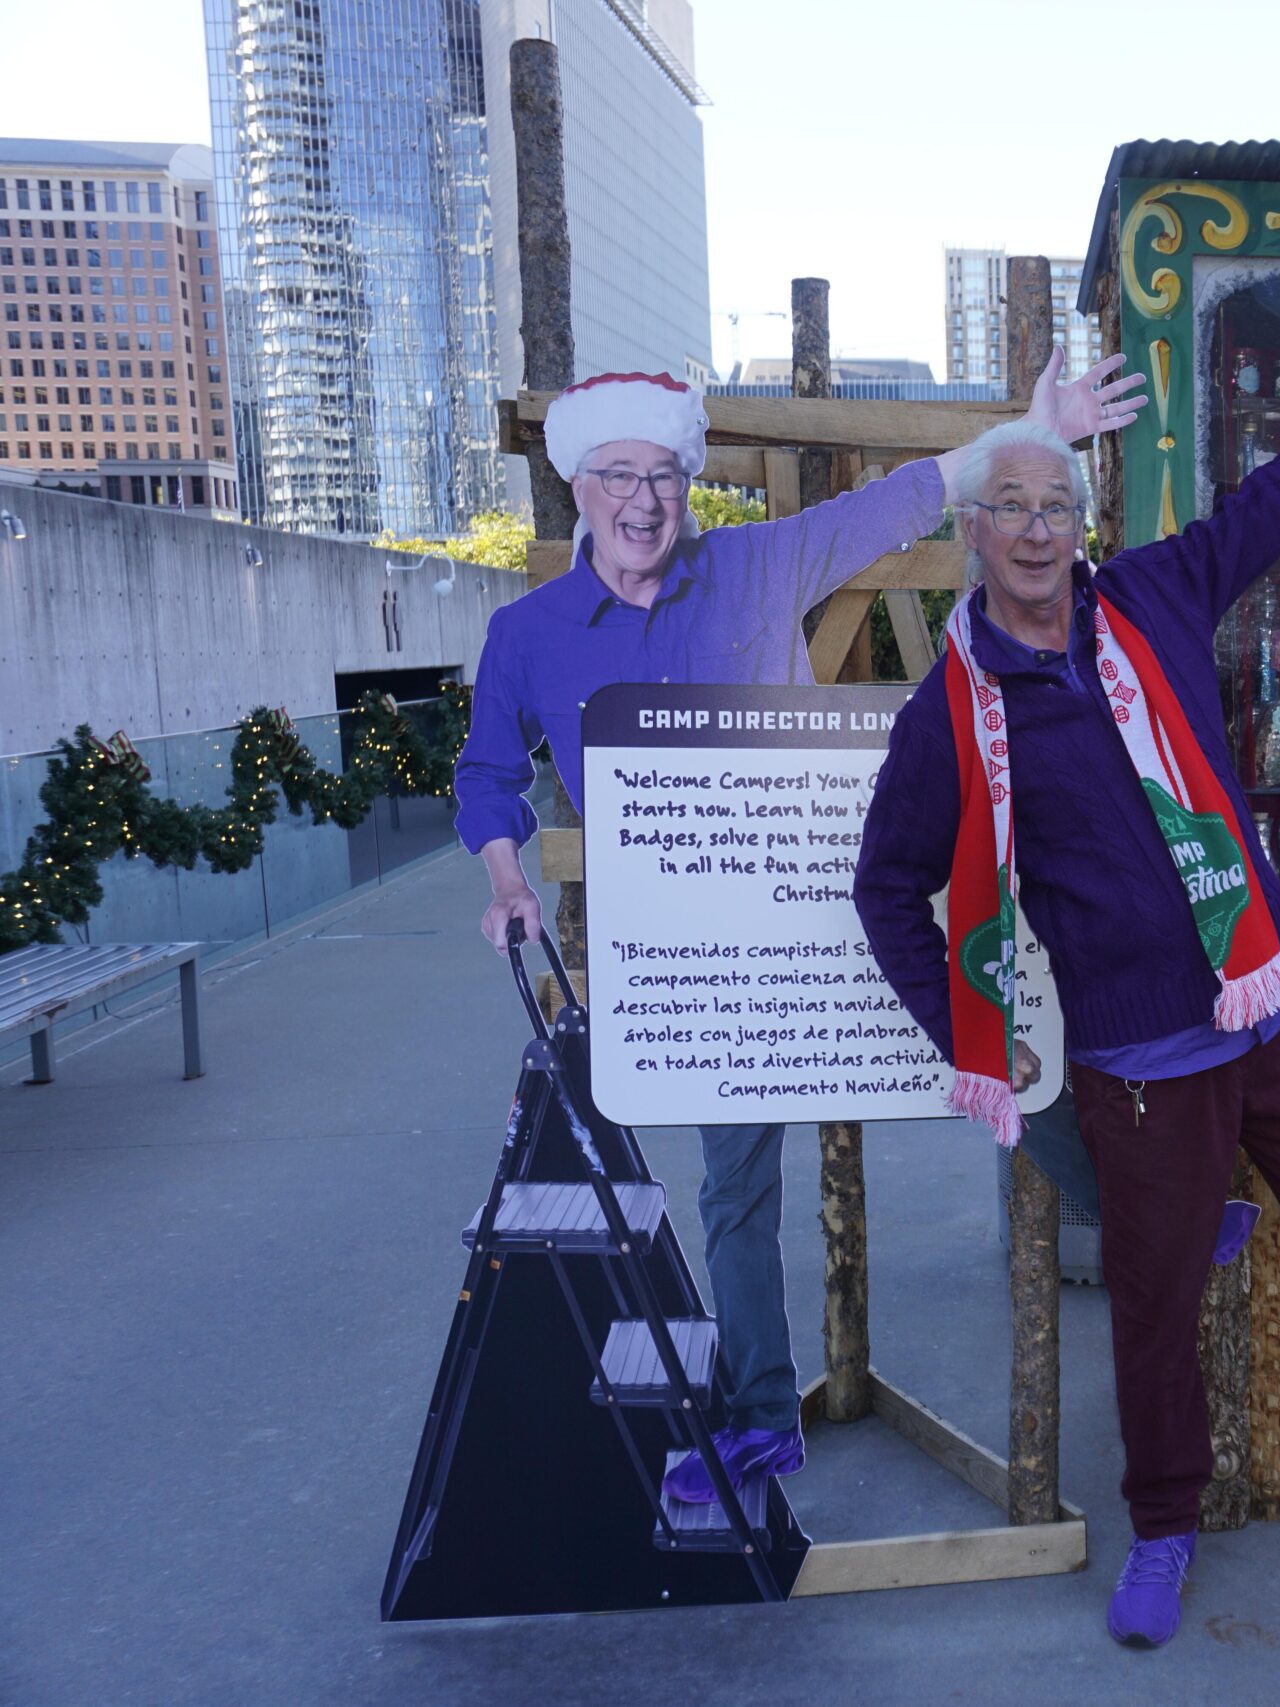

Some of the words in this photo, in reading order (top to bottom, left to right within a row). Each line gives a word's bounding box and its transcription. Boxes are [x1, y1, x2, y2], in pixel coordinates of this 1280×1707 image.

[639, 709, 710, 730] CAMP
[718, 710, 841, 731] DIRECTOR
[850, 712, 895, 731] LON
[719, 770, 810, 793] Campers!
[816, 772, 861, 792] Your
[622, 800, 687, 818] starts
[693, 804, 737, 818] now.
[744, 800, 804, 818] Learn
[811, 799, 848, 818] how
[619, 828, 703, 850] Badges,
[709, 827, 759, 847] solve
[766, 832, 800, 850] pun
[806, 828, 862, 846] trees
[658, 856, 678, 875] in
[685, 855, 712, 875] all
[719, 855, 757, 875] the
[763, 856, 800, 874] fun
[1169, 841, 1206, 868] MP
[773, 884, 854, 903] Christm
[746, 939, 847, 961] campistas!
[628, 970, 751, 989] campamento
[757, 969, 847, 986] comienza
[853, 967, 887, 984] aho
[612, 997, 708, 1016] descubrir
[713, 996, 742, 1015] las
[747, 996, 828, 1019] insignias
[834, 996, 909, 1013] navide
[1020, 991, 1043, 1008] los
[622, 1025, 693, 1044] árboles
[699, 1029, 732, 1043] con
[735, 1025, 797, 1047] juegos
[802, 1024, 829, 1042] de
[835, 1022, 919, 1044] palabras
[635, 1058, 658, 1071] en
[664, 1054, 721, 1071] todas
[727, 1051, 756, 1070] las
[761, 1051, 864, 1070] divertidas
[870, 1050, 949, 1066] activida
[717, 1079, 839, 1100] Campamento
